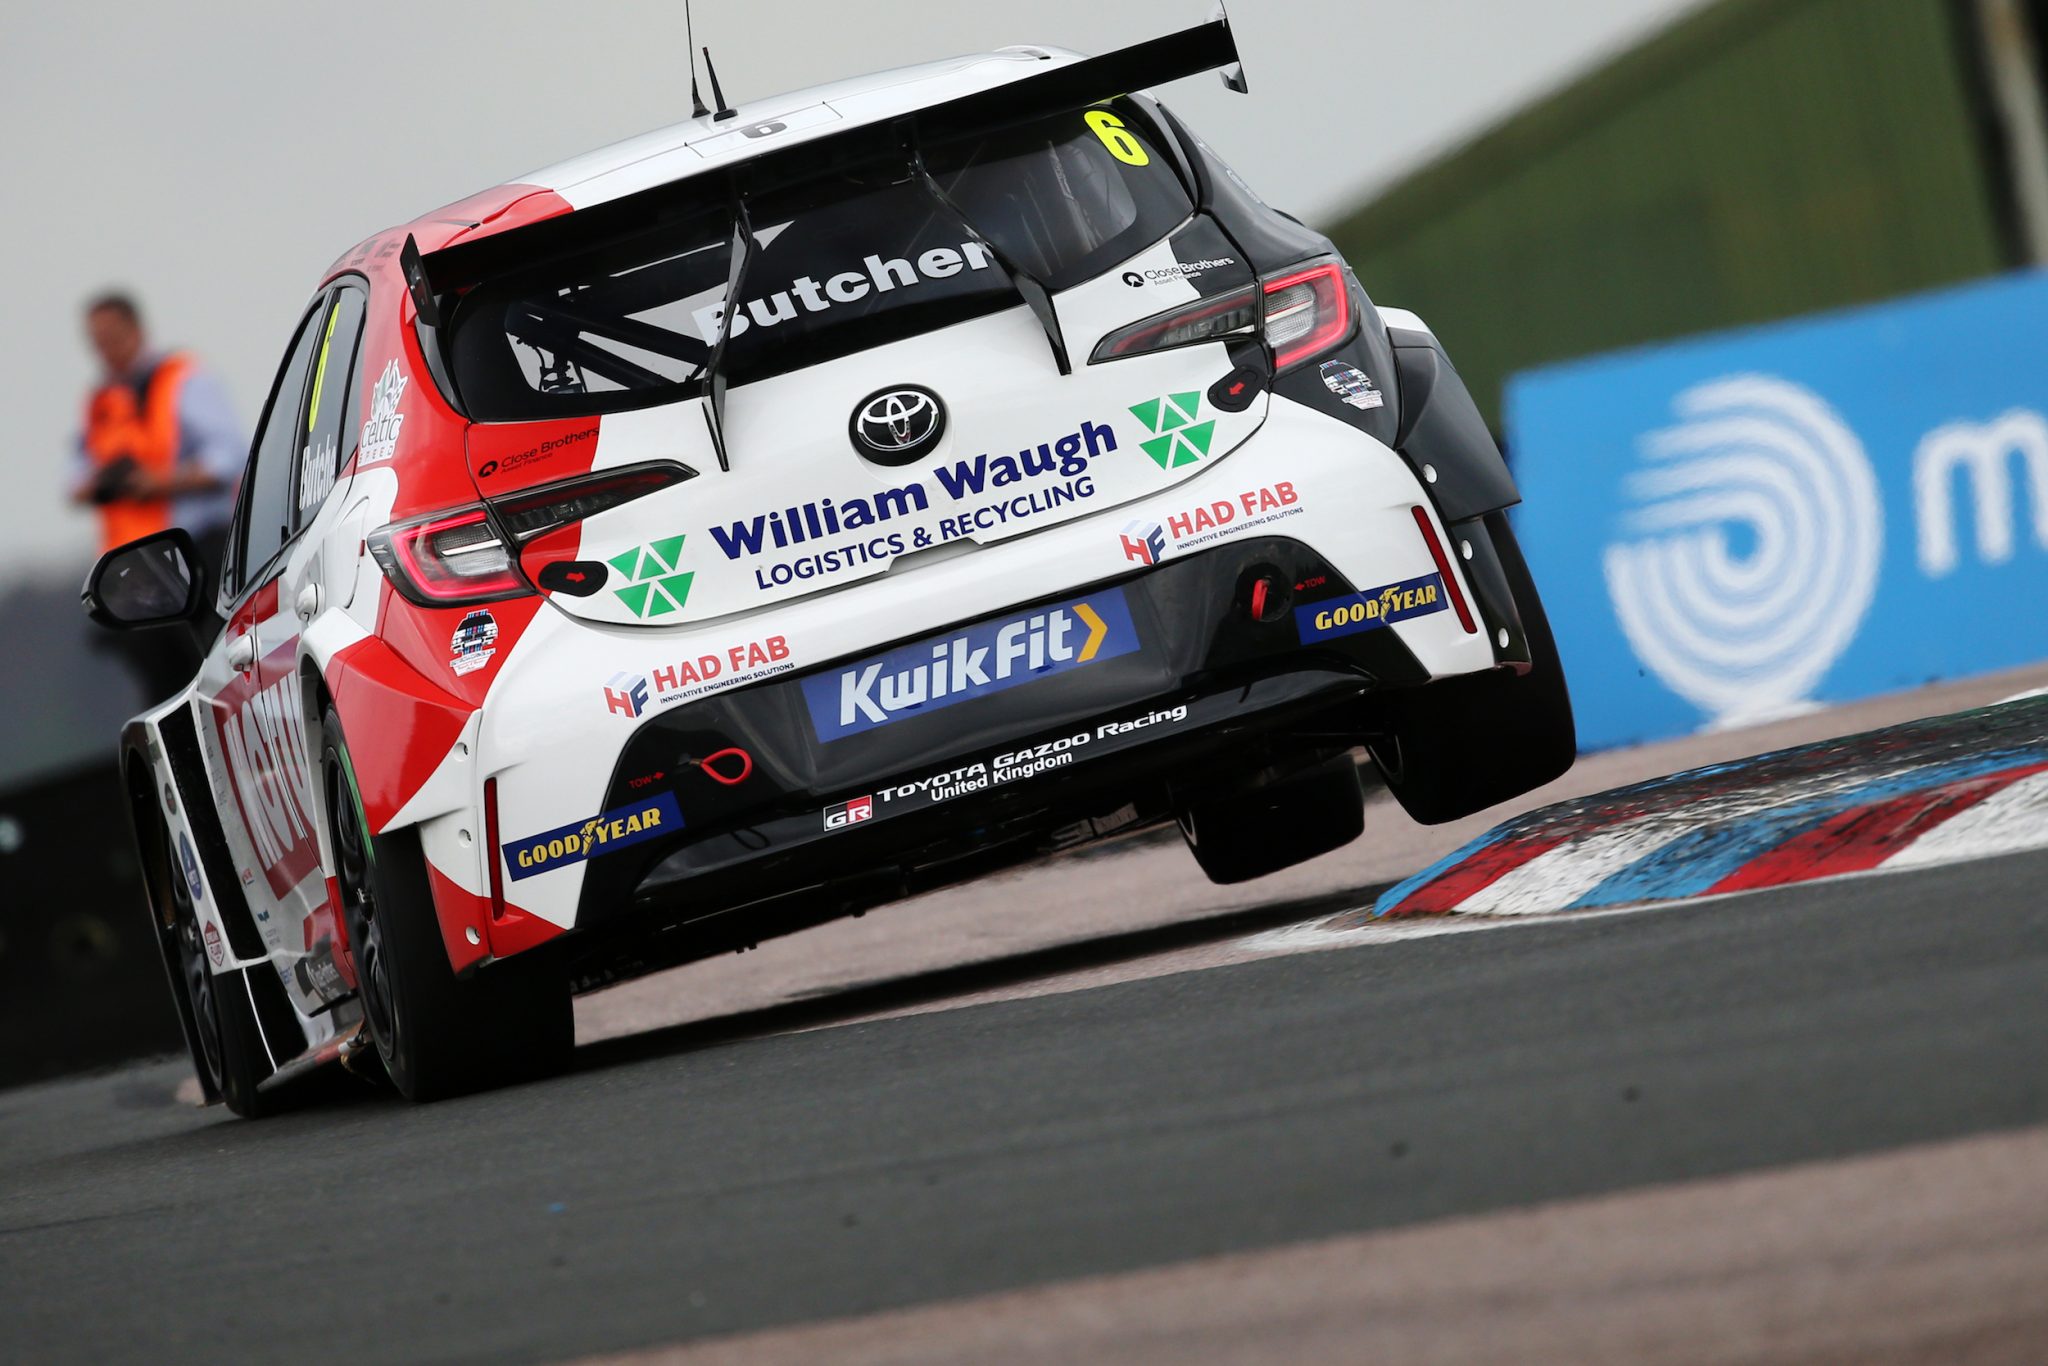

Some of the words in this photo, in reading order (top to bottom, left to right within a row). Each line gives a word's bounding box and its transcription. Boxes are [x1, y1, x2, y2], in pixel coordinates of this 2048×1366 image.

[740, 119, 788, 139] 6
[1083, 110, 1150, 167] 6
[1144, 265, 1181, 280] Close
[1179, 256, 1235, 273] Brothers
[692, 240, 994, 347] Butcher
[501, 449, 538, 468] Close
[541, 428, 600, 453] Brothers
[709, 483, 928, 560] William
[933, 420, 1118, 501] Waugh
[1167, 500, 1235, 539] HAD
[1239, 481, 1299, 517] FAB
[755, 533, 905, 590] LOGISTICS
[913, 526, 933, 548] &
[940, 476, 1095, 540] RECYCLING
[1176, 533, 1219, 551] INNOVATIVE
[1219, 518, 1266, 538] ENGINEERING
[1266, 507, 1304, 522] SOLUTIONS
[1304, 576, 1326, 588] TOW
[652, 654, 722, 693] HAD
[728, 635, 790, 672] FAB
[659, 687, 703, 704] INNOVATIVE
[703, 674, 753, 692] ENGINEERING
[753, 662, 795, 679] SOLUTIONS
[877, 763, 986, 802] TOYOTA
[993, 733, 1091, 769] GAZOO
[1097, 705, 1188, 740] Racing
[931, 774, 989, 802] United
[993, 752, 1073, 785] Kingdom
[629, 775, 653, 789] TOW
[825, 805, 871, 829] GR
